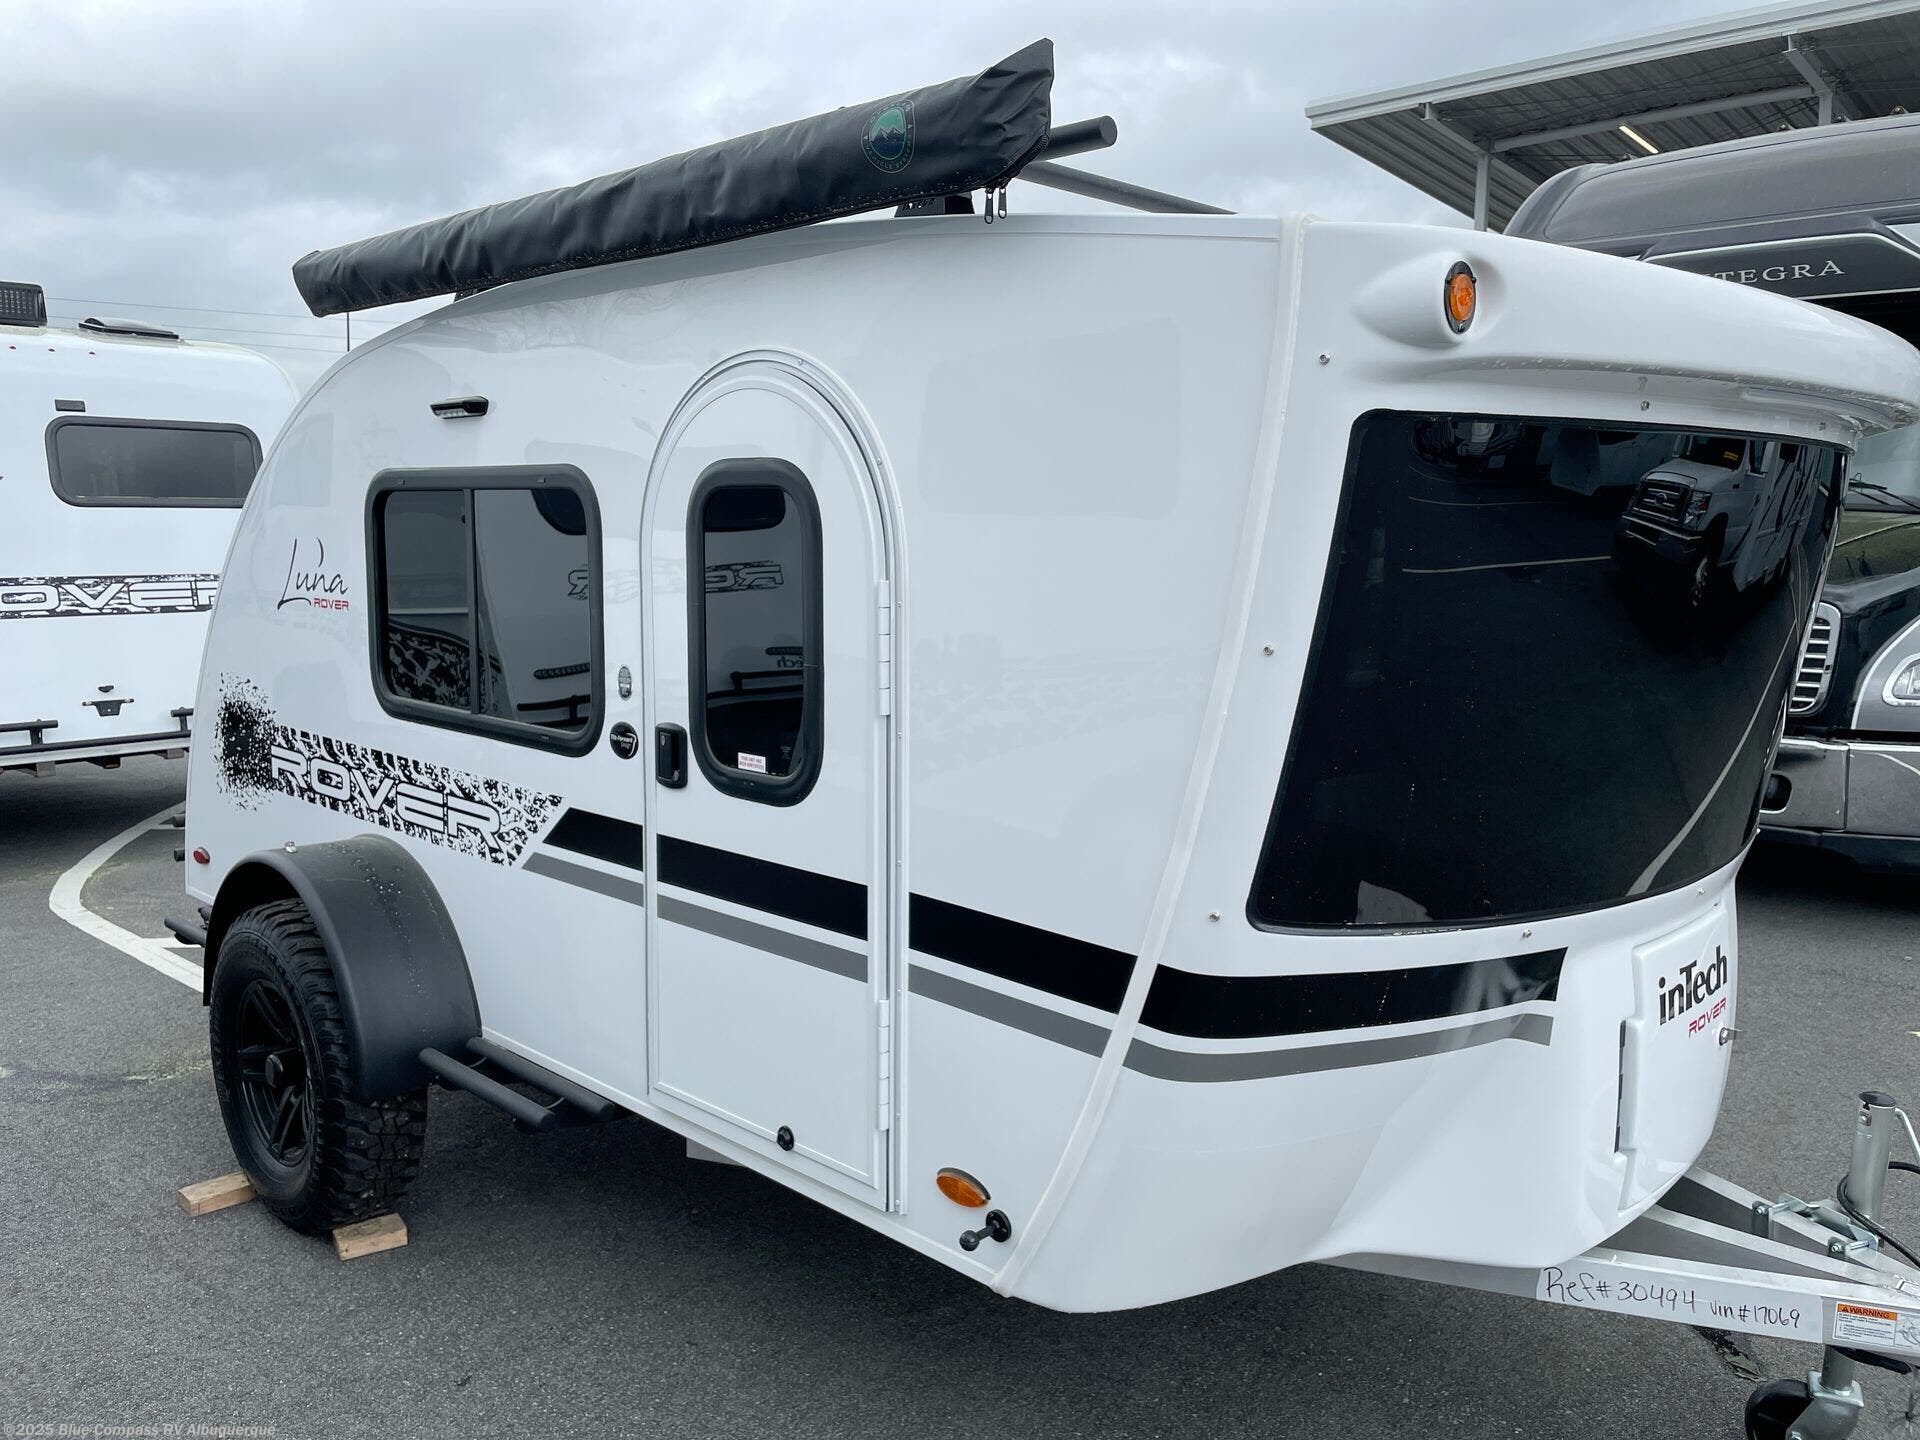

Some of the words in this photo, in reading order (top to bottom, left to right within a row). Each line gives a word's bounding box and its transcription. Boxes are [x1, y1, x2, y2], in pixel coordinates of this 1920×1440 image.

[1700, 260, 1845, 284] TEGRA
[277, 537, 349, 610] Luna
[313, 597, 349, 611] ROVER
[270, 744, 501, 851] ROVER
[1658, 944, 1728, 1026] inTech
[1688, 997, 1727, 1038] ROVER
[1849, 1306, 1890, 1320] WARNING
